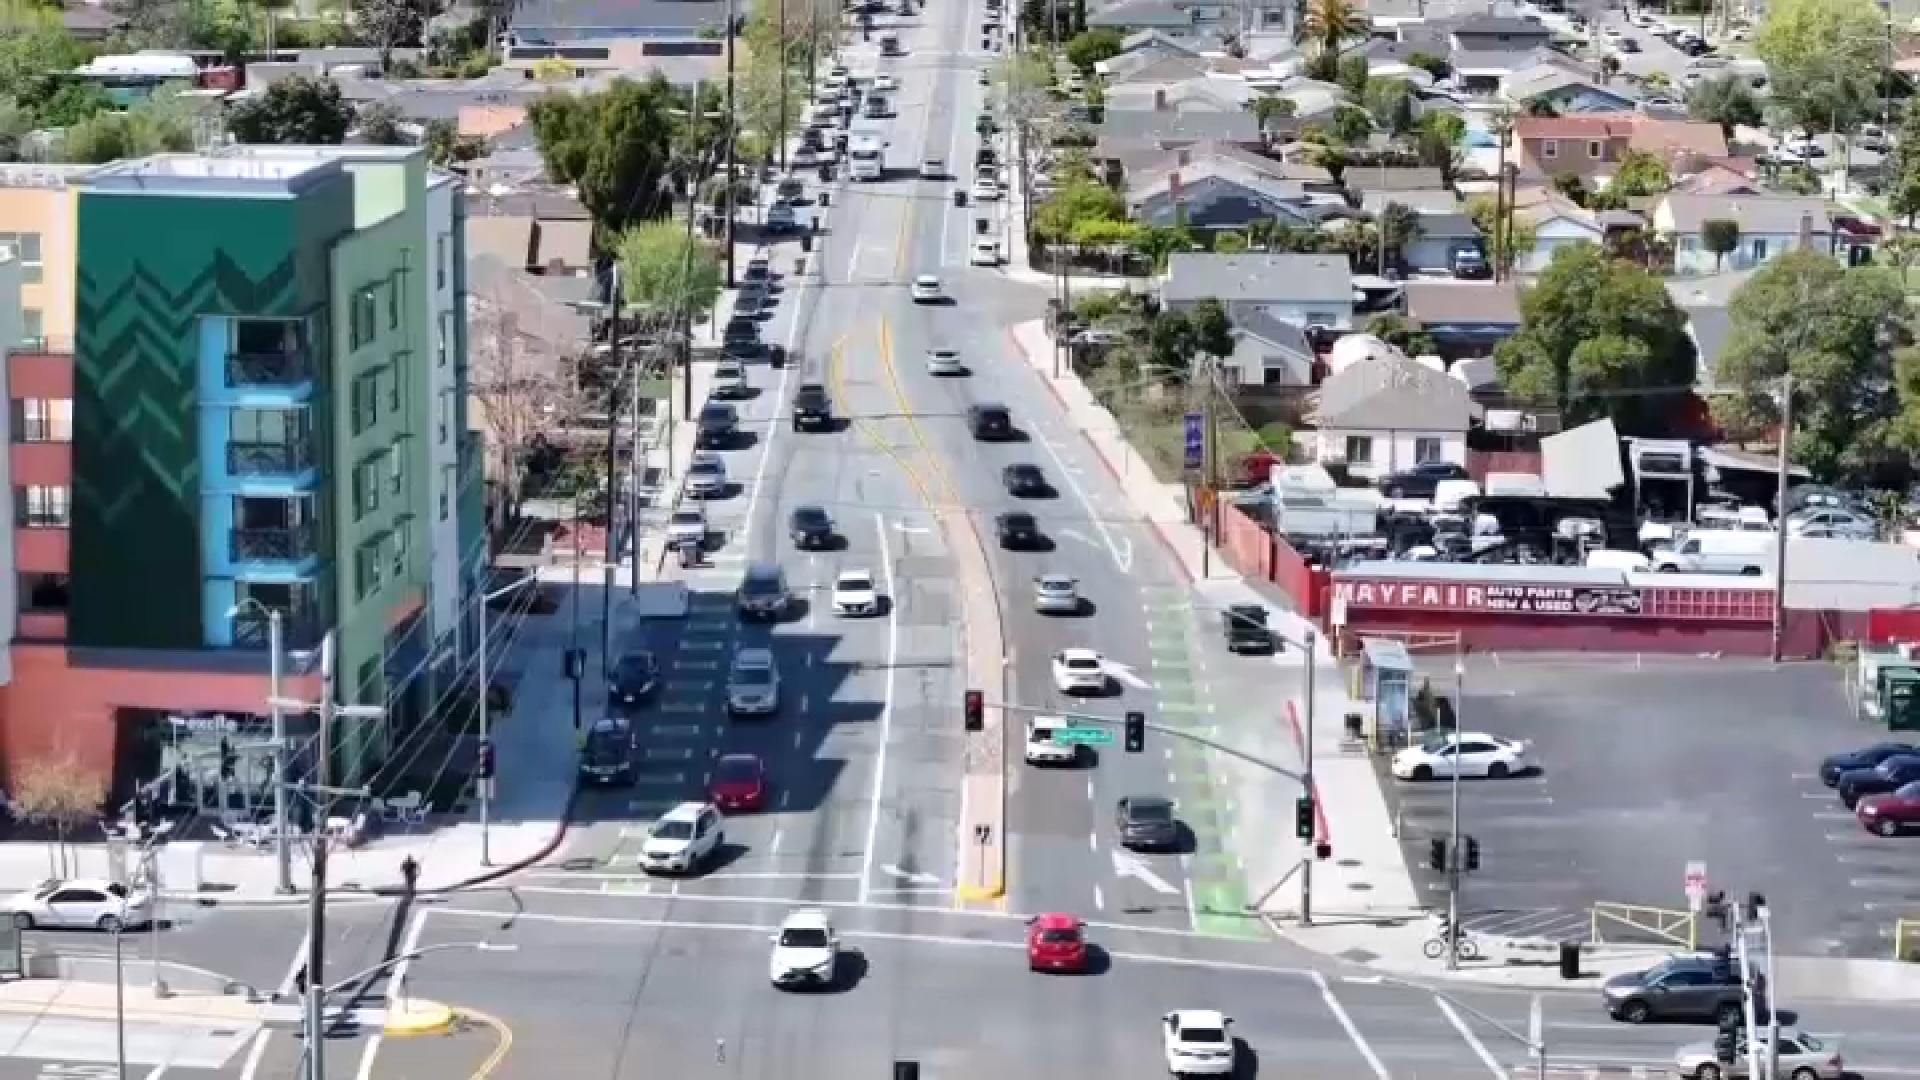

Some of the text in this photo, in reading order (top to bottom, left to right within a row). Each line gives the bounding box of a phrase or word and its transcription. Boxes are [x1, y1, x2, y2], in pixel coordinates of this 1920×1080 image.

[1335, 583, 1482, 605] MAYFAIR
[1488, 586, 1523, 597] AUTO
[1528, 587, 1572, 598] PARTS
[1488, 598, 1572, 610] NEW & USED
